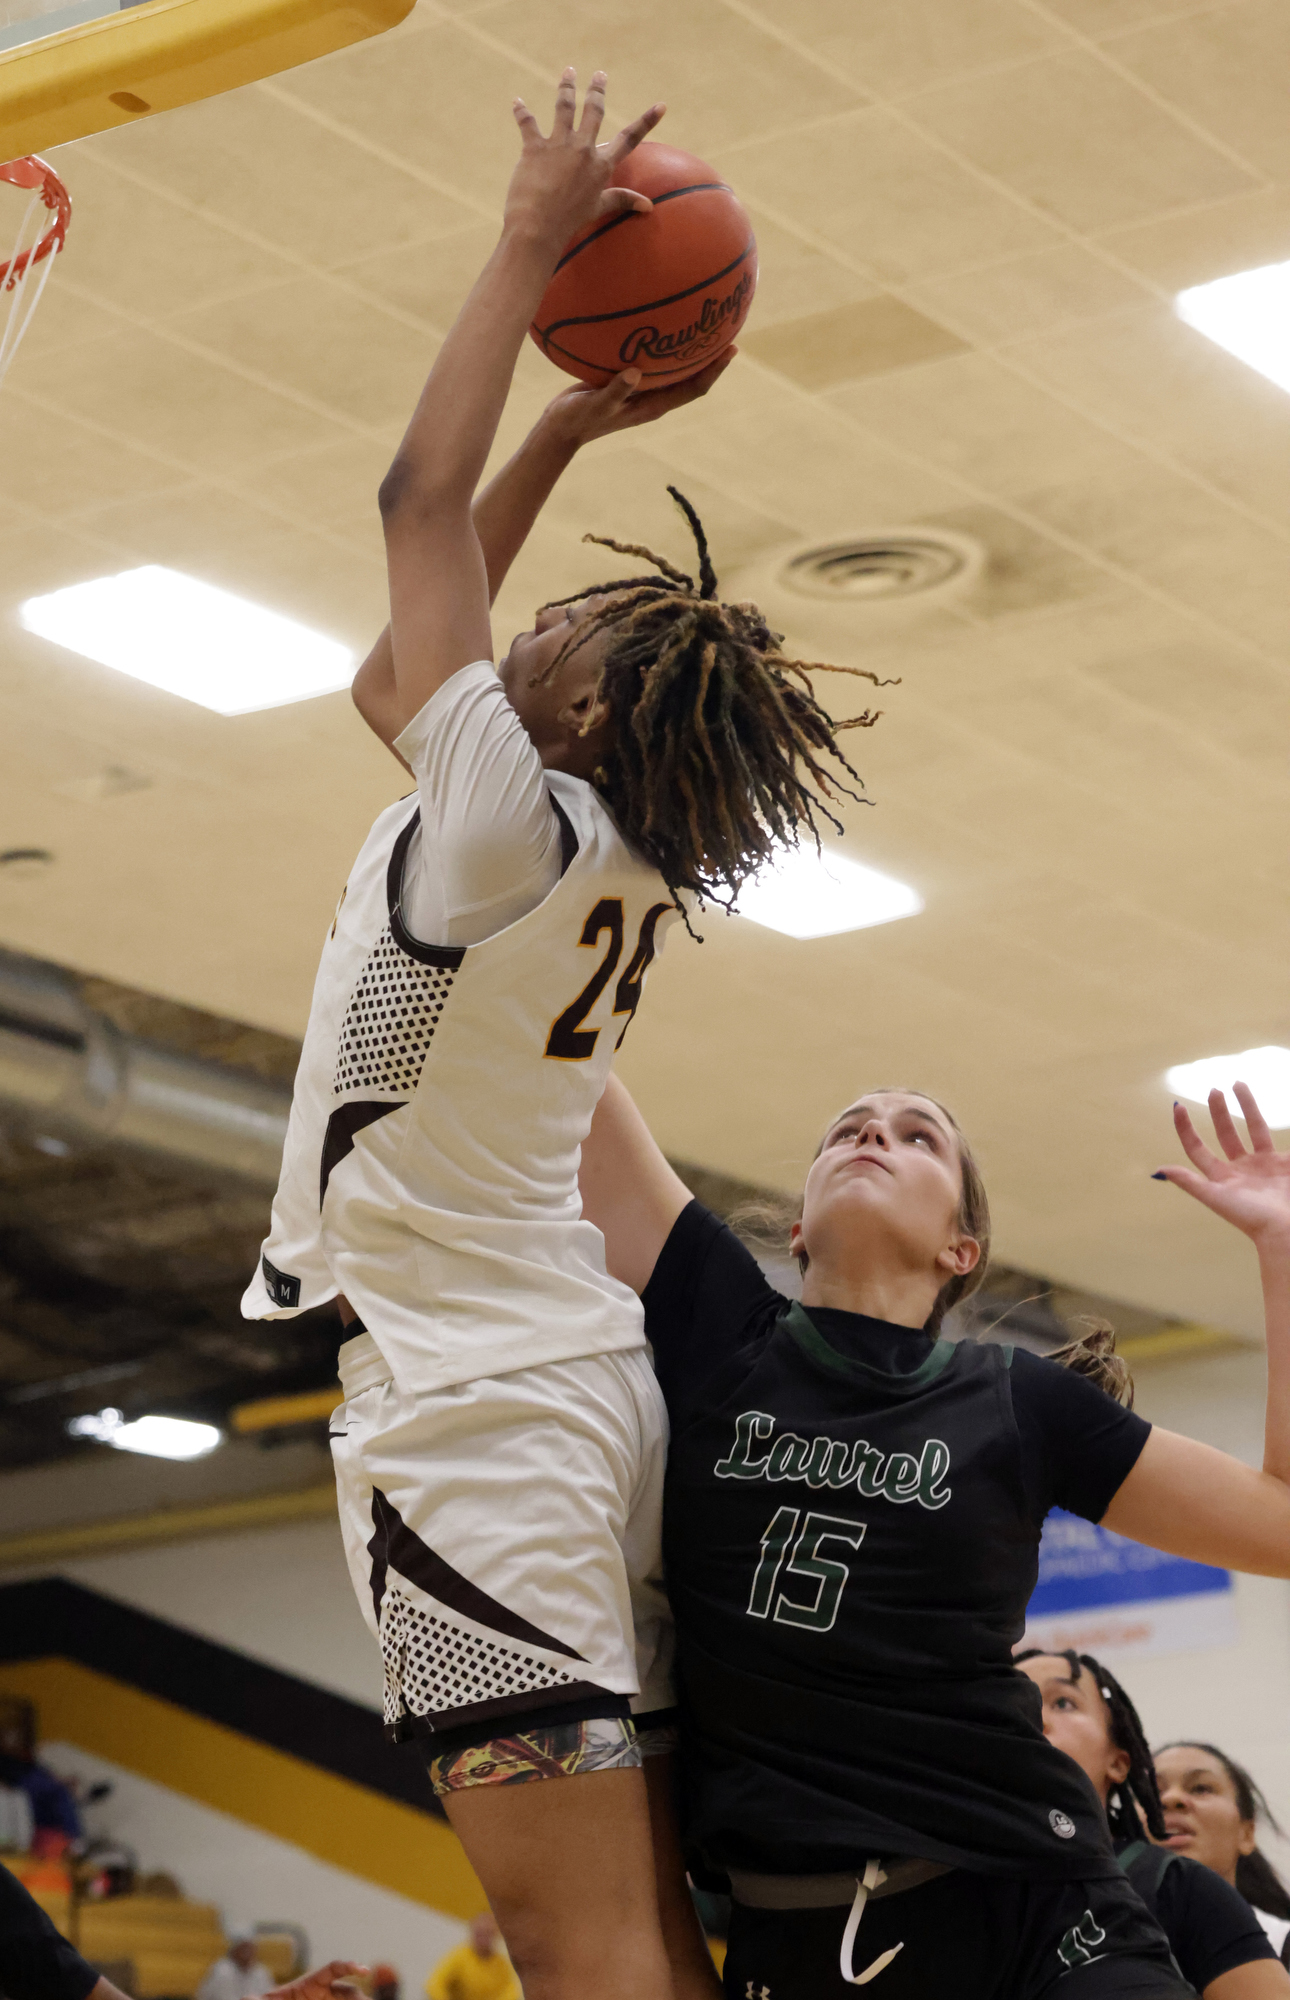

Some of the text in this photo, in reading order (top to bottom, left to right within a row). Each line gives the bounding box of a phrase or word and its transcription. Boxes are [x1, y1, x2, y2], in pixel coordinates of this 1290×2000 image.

[543, 896, 677, 1062] 24
[281, 1283, 290, 1300] M
[714, 1411, 951, 1510] Laurel
[746, 1506, 867, 1632] 15
